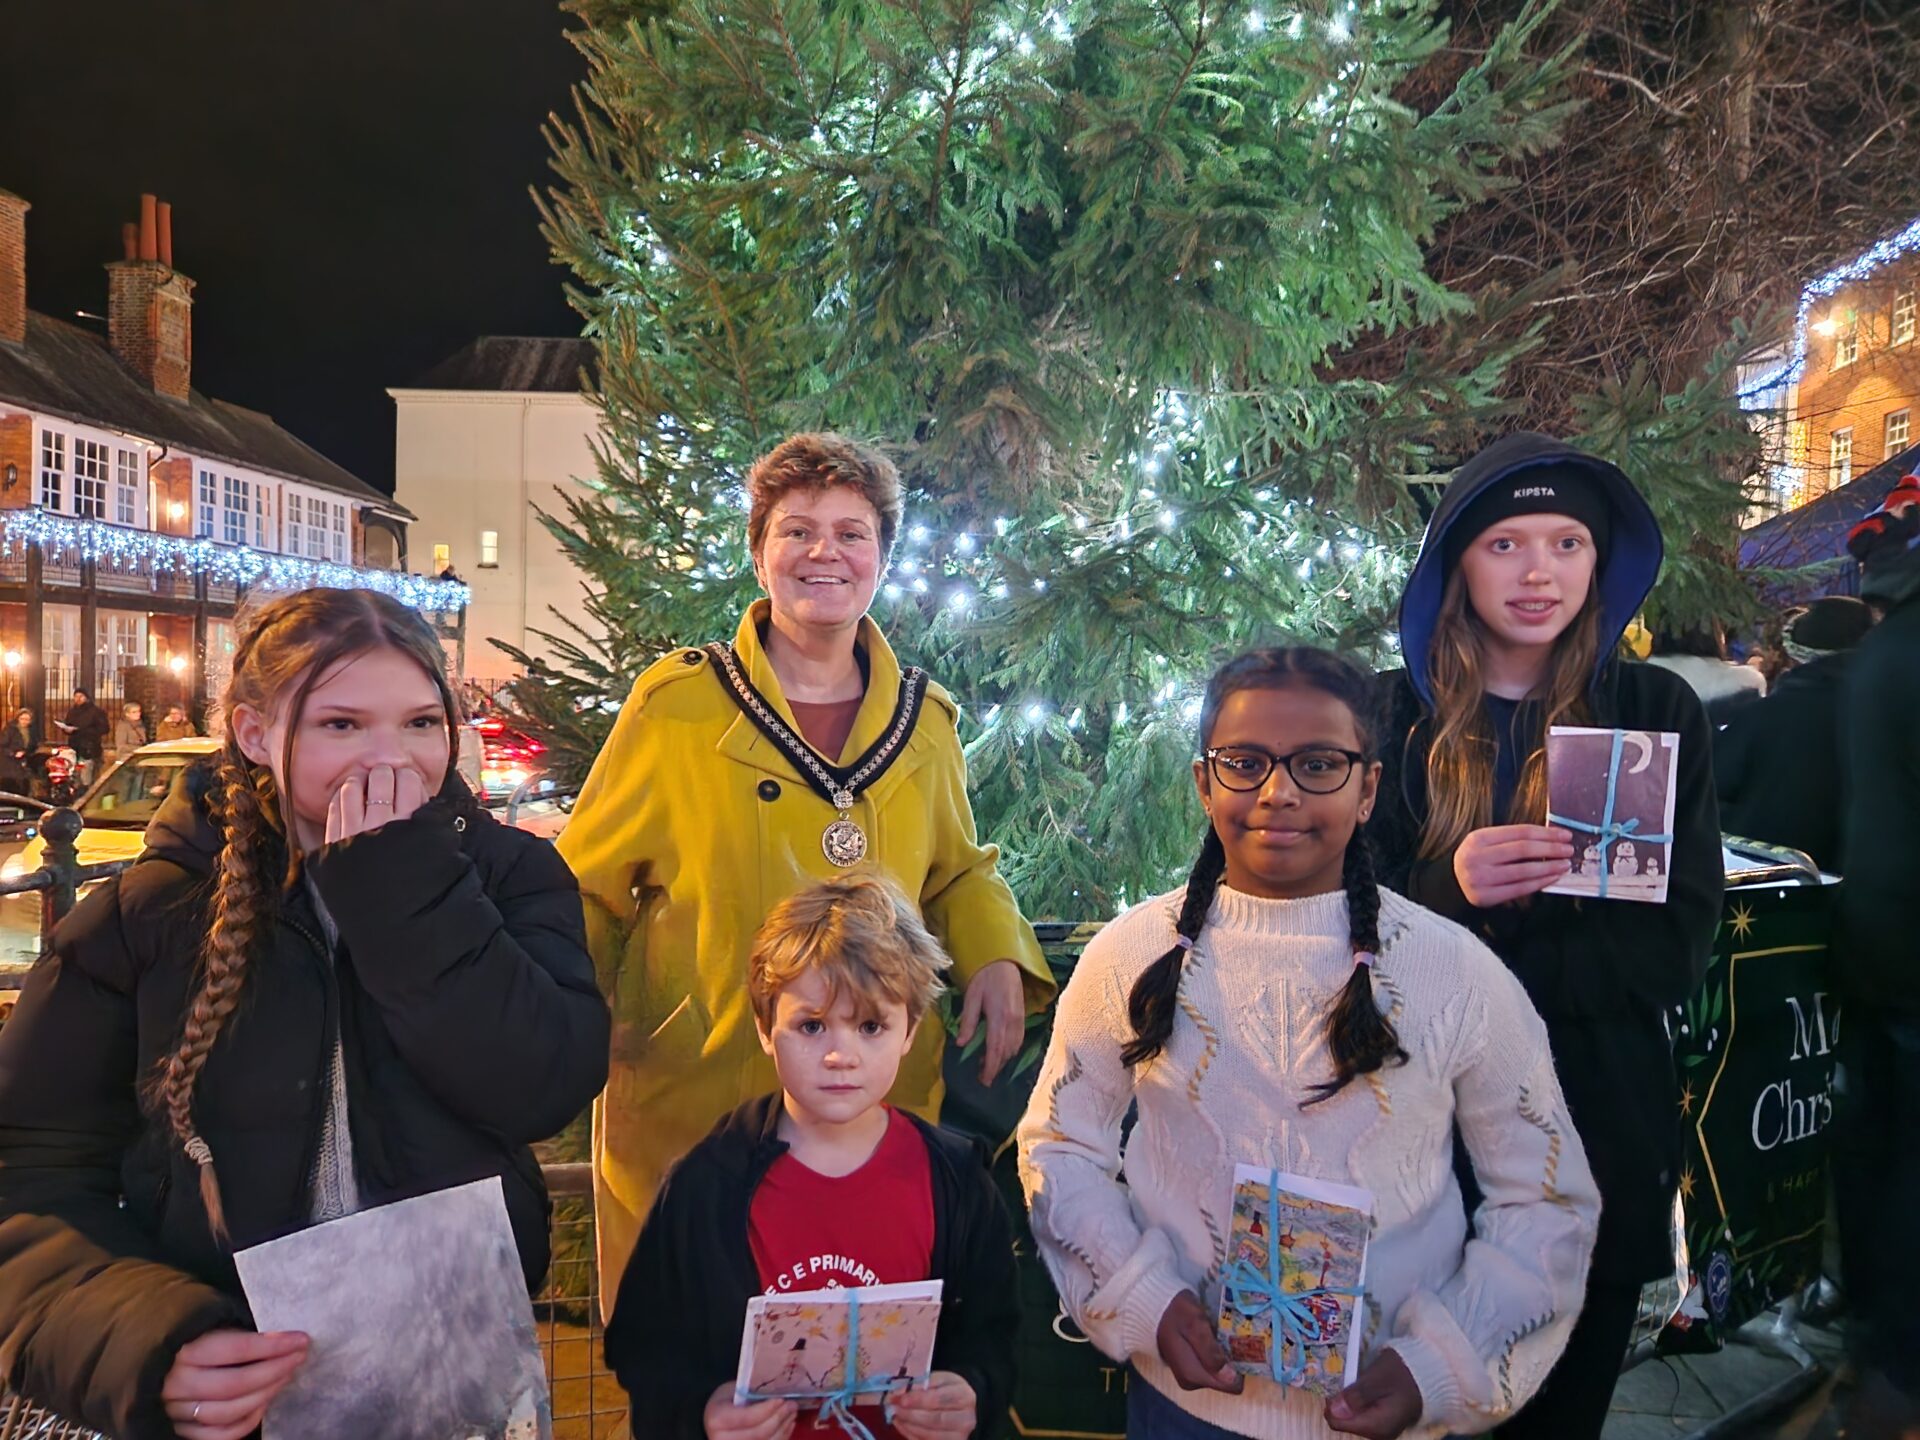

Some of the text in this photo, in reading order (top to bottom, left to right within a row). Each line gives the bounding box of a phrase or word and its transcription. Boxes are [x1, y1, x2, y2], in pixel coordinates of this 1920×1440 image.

[1513, 486, 1556, 499] KIPSTA
[777, 1273, 792, 1290] C
[792, 1262, 807, 1280] E
[809, 1254, 883, 1287] PRIMARY
